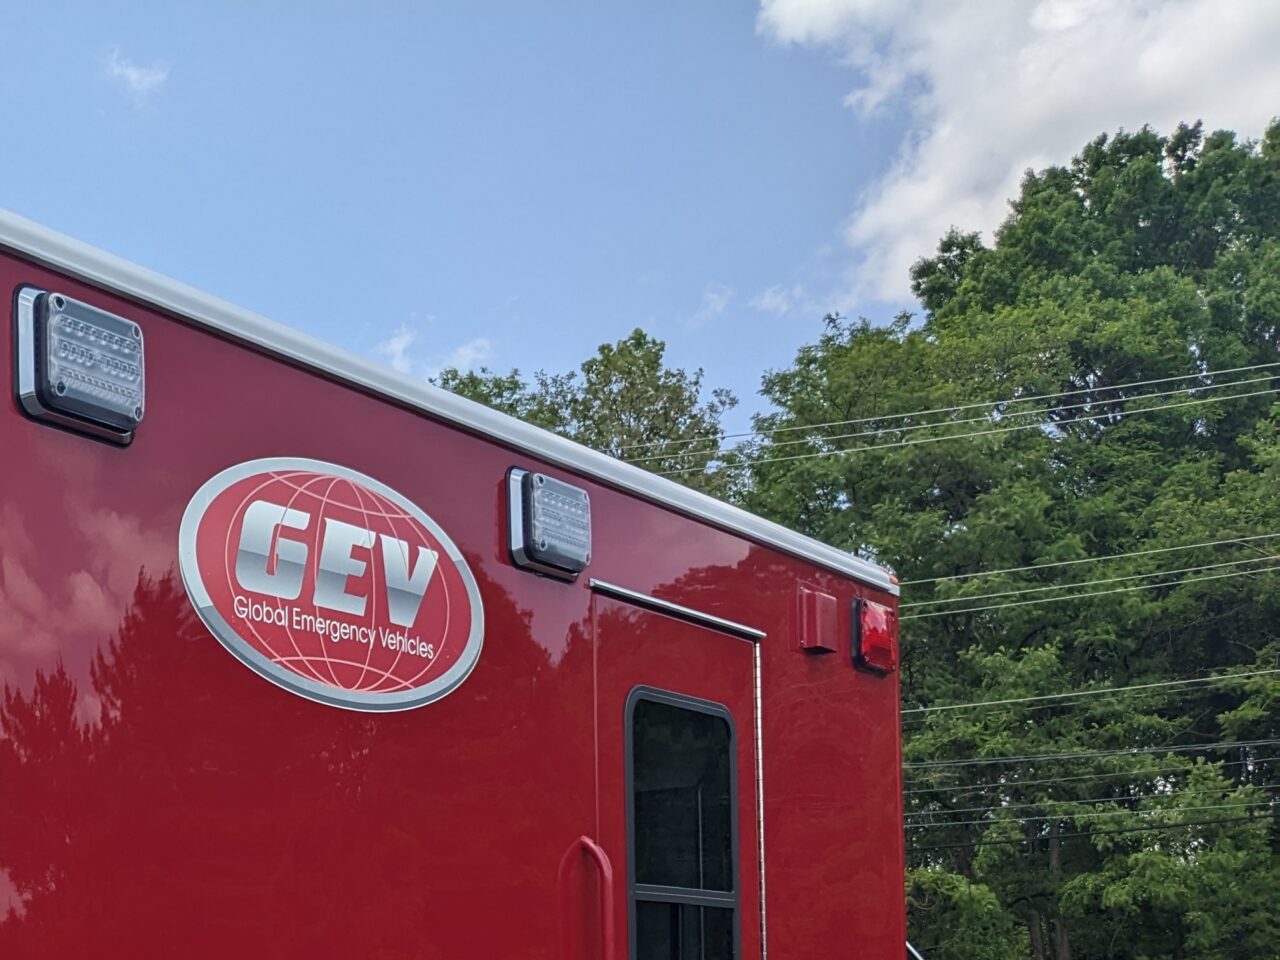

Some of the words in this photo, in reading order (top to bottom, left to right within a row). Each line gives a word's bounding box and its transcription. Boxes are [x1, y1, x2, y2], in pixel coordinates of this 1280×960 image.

[234, 499, 439, 629] GEV
[233, 595, 289, 627] Global
[292, 607, 376, 646] Emergency
[379, 626, 435, 660] Vehicles
